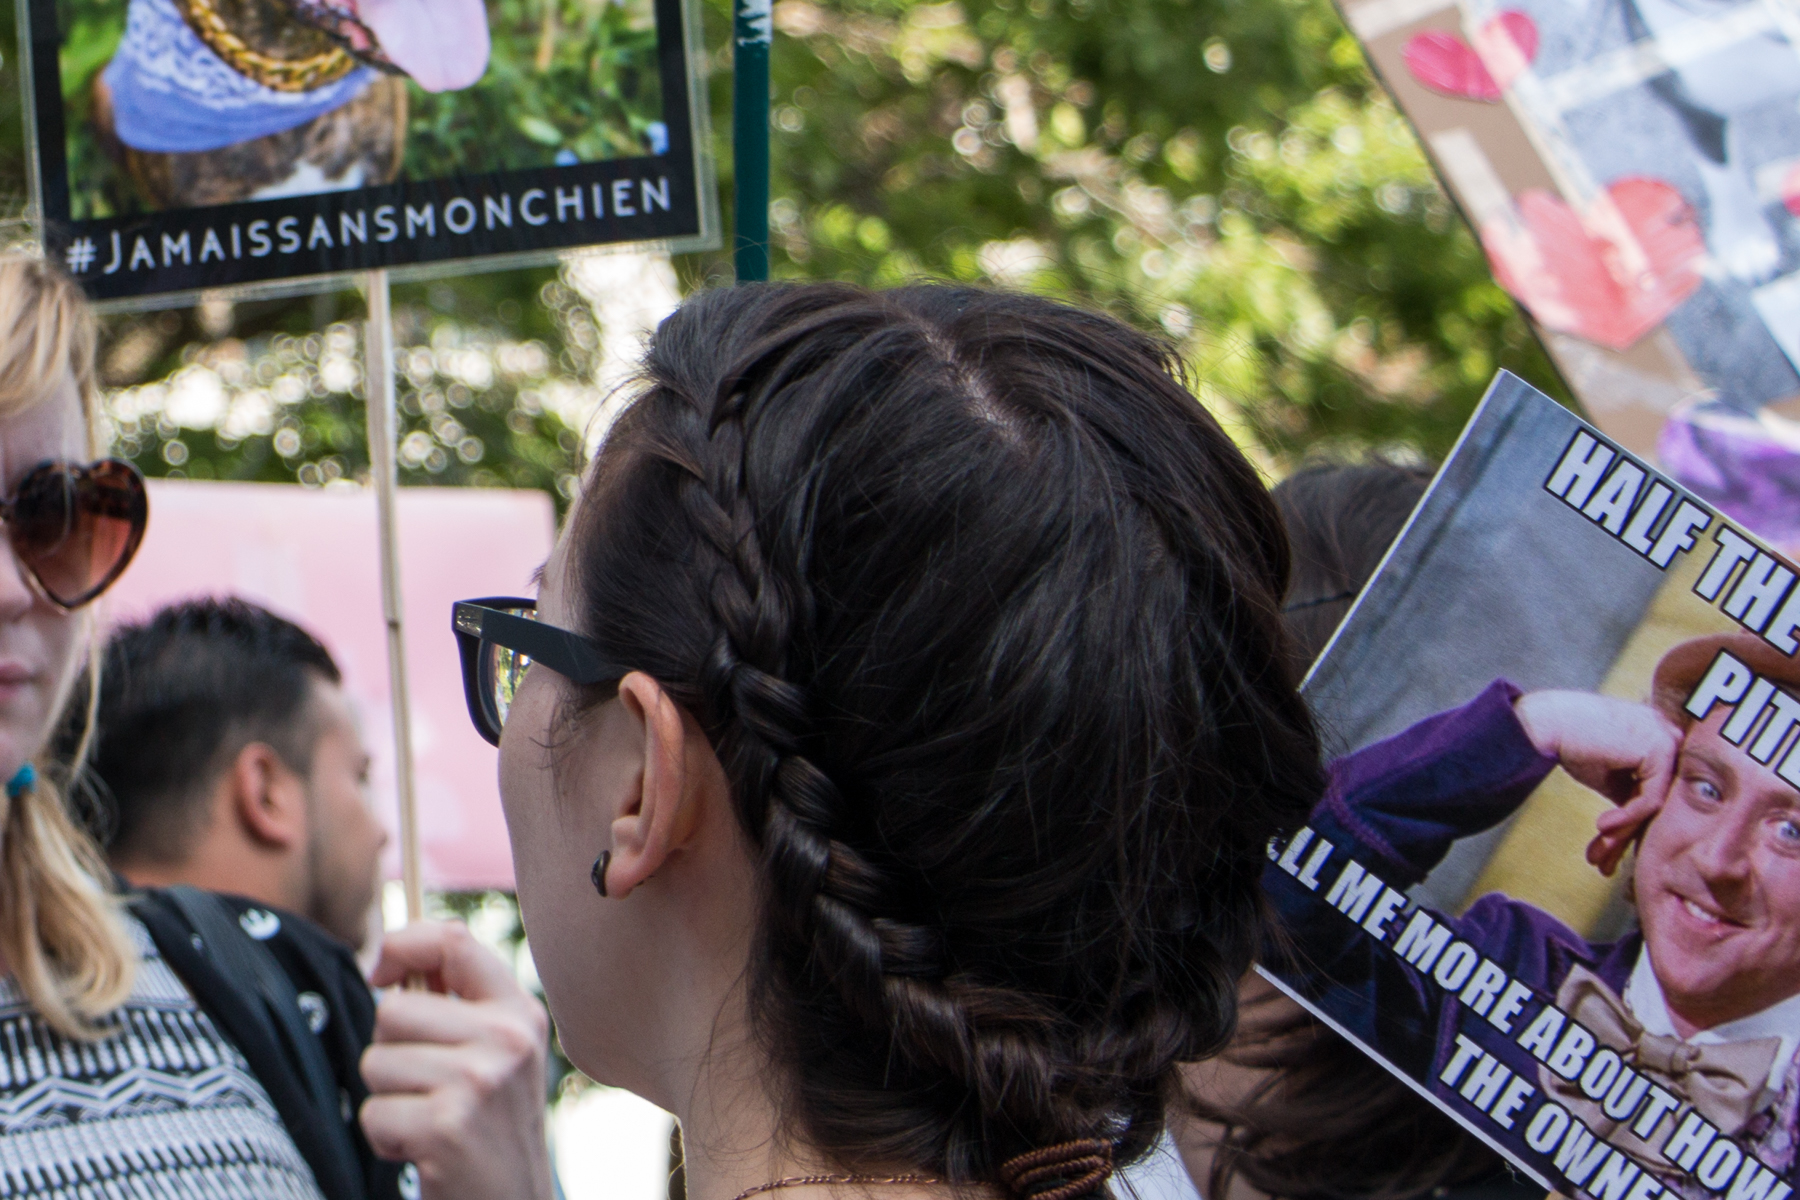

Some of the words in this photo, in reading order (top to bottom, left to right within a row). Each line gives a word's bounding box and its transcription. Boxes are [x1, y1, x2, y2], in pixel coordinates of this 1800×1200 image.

[65, 174, 672, 275] #JAMAISSANSMONCHIEN
[1544, 427, 1713, 571] HALF
[1682, 649, 1800, 792] PIT
[1324, 858, 1408, 941] ME
[1392, 908, 1534, 1035] MORE
[1516, 1004, 1680, 1141] ABOUT
[1661, 1106, 1795, 1200] HOW
[1439, 1033, 1536, 1130] THE
